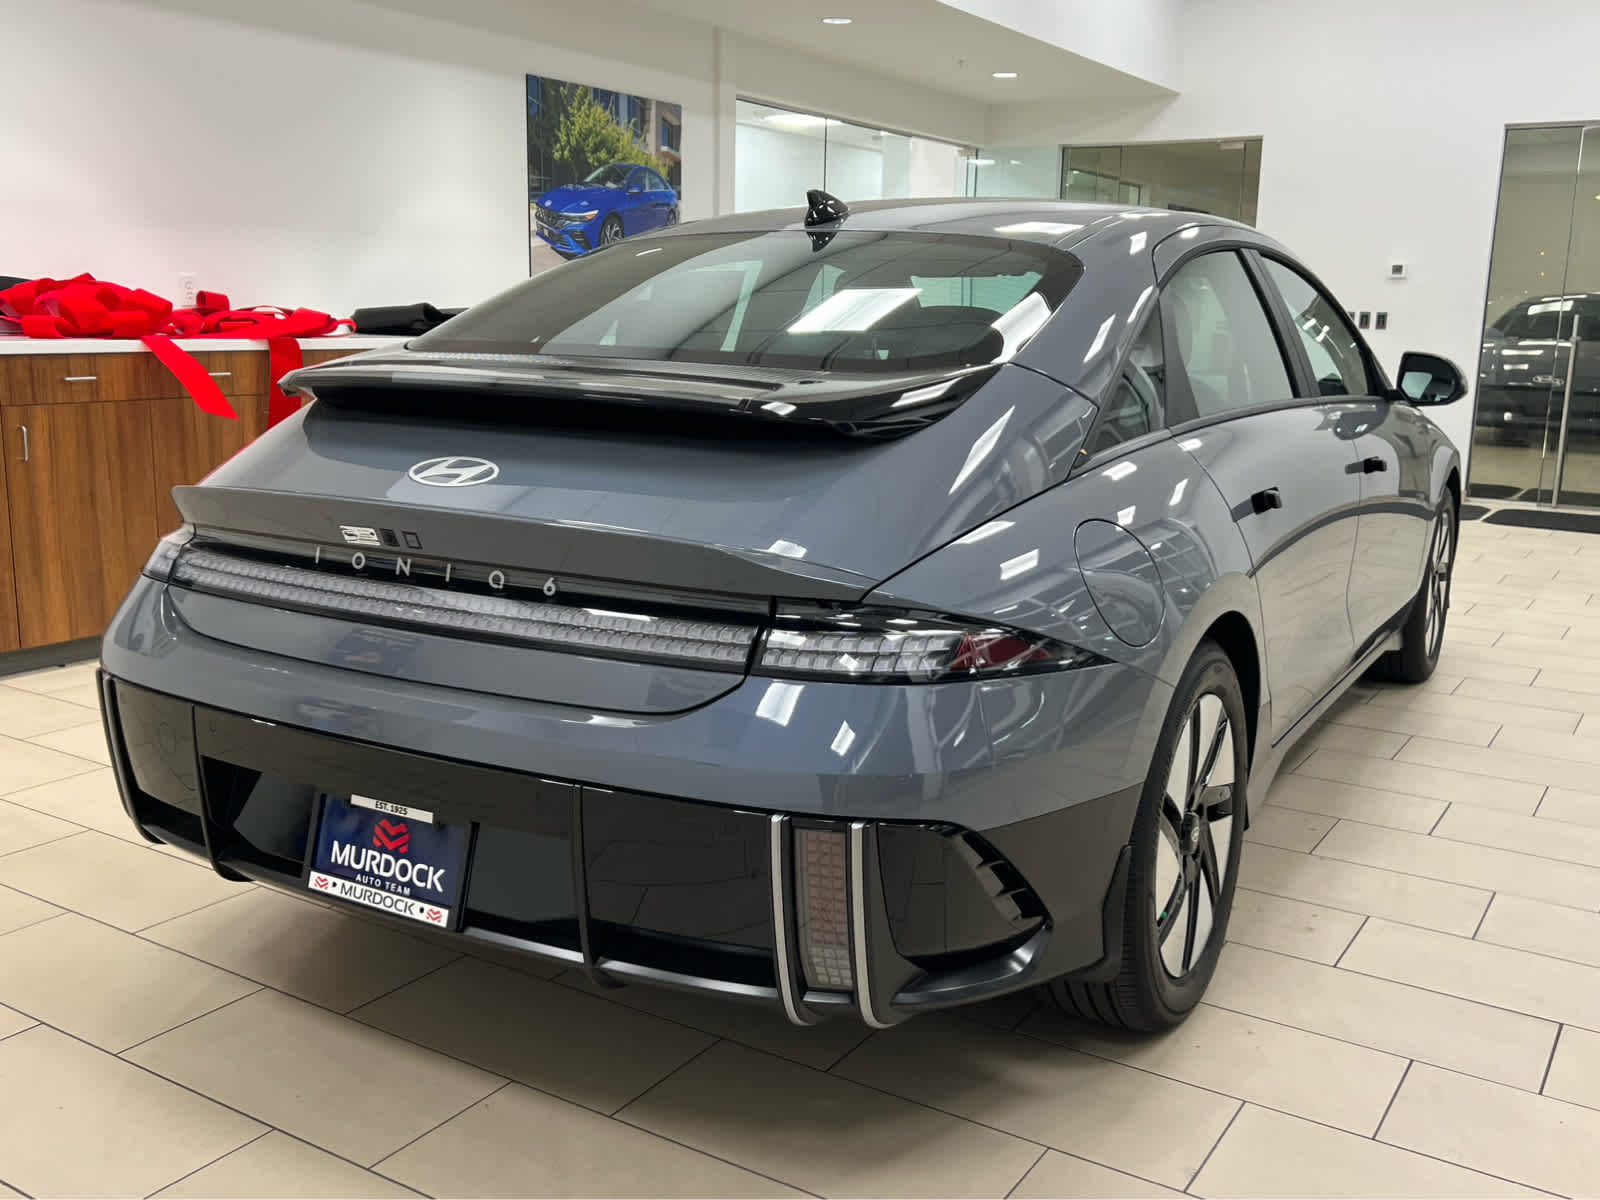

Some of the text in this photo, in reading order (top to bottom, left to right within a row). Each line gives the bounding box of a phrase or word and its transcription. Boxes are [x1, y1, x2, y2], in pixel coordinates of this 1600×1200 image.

[375, 800, 408, 816] EST. 1925
[330, 840, 446, 893] MURDOCK
[355, 873, 411, 896] AUTO TEAM
[340, 882, 416, 916] MURDOCK
